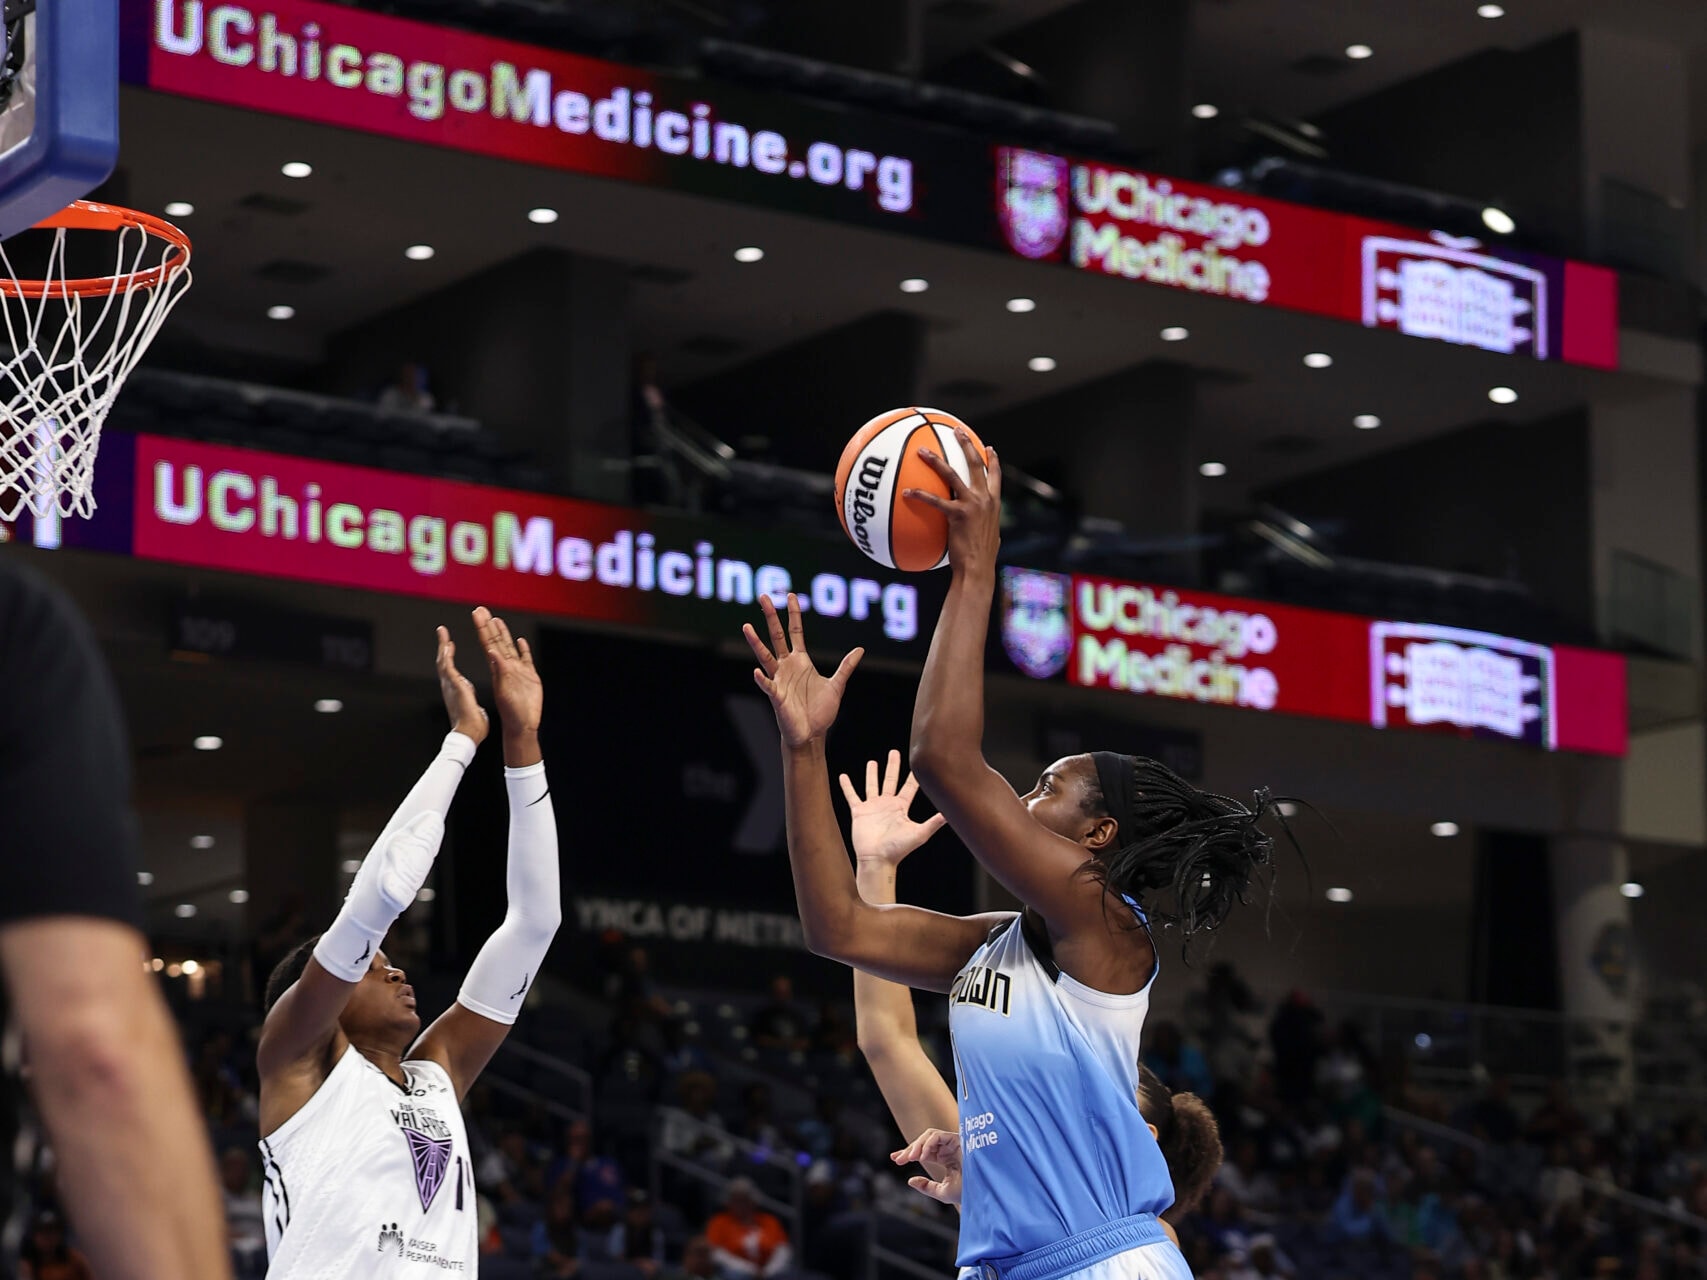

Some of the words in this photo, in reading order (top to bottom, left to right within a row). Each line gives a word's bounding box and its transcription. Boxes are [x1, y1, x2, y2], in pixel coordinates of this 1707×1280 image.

[154, 0, 914, 213] UChicagoMedicine.org
[1071, 164, 1271, 250] UChicago
[1071, 216, 1272, 303] Medicine
[853, 456, 889, 555] Wilson
[153, 459, 918, 641] UChicagoMedicine.org
[1079, 580, 1278, 659] UChicago
[1079, 634, 1280, 710] Medicine
[573, 897, 664, 936] YMCA
[668, 903, 710, 939] OF
